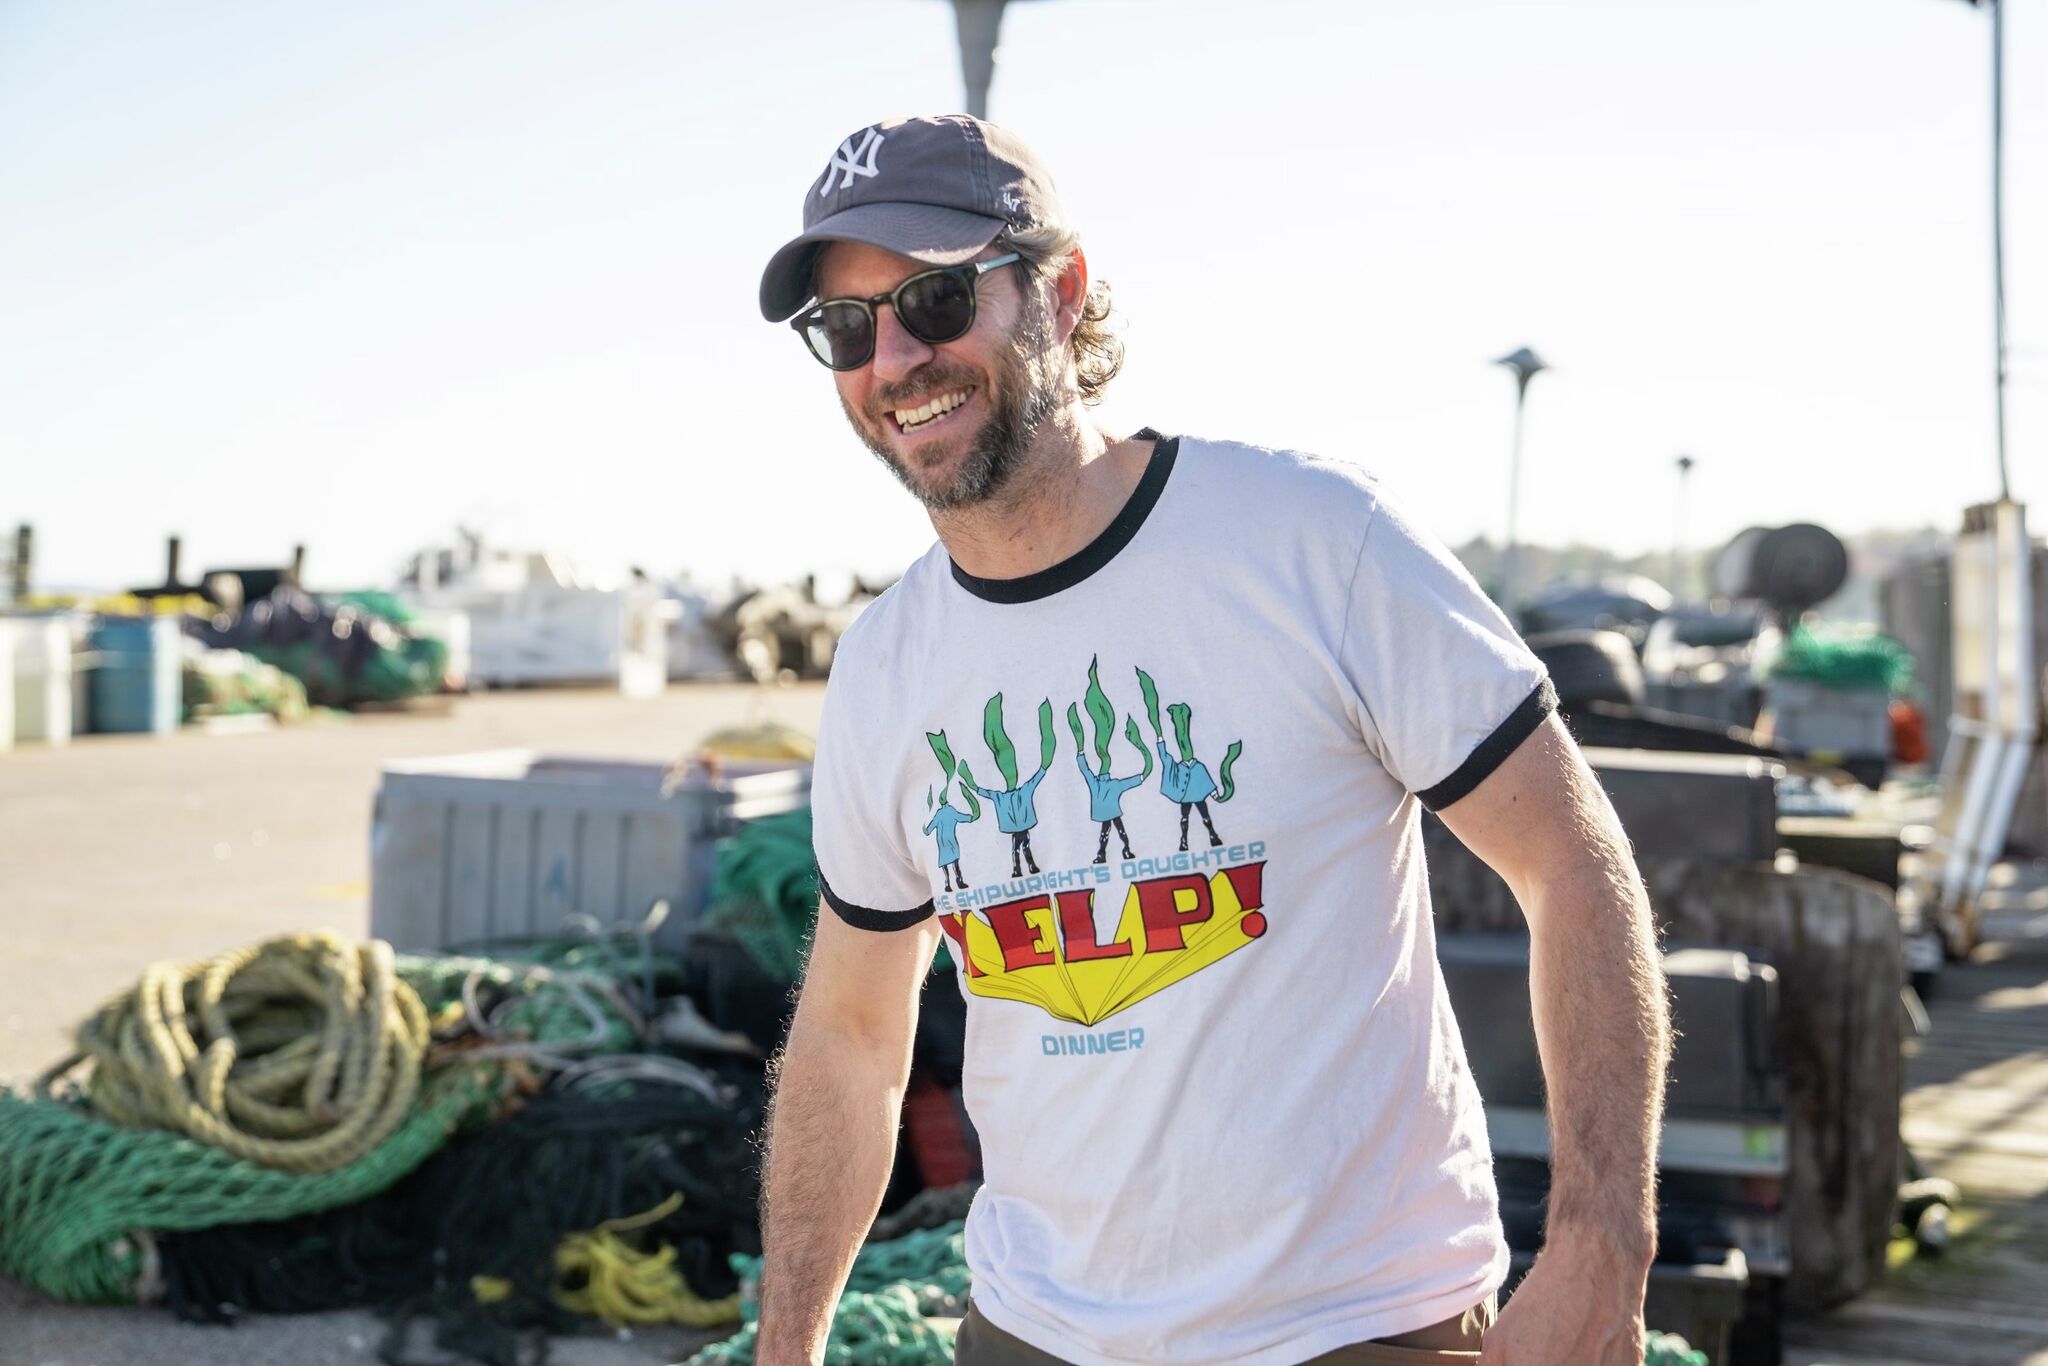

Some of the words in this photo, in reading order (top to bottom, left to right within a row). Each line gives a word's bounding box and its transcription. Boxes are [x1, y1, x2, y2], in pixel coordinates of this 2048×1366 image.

[820, 126, 885, 198] NY
[936, 894, 953, 911] HE
[955, 862, 1111, 907] SHIPWRIGHT'S
[1121, 840, 1266, 879] DAUGHTER
[938, 860, 1268, 978] YELP!
[1041, 1027, 1145, 1056] DINNER
